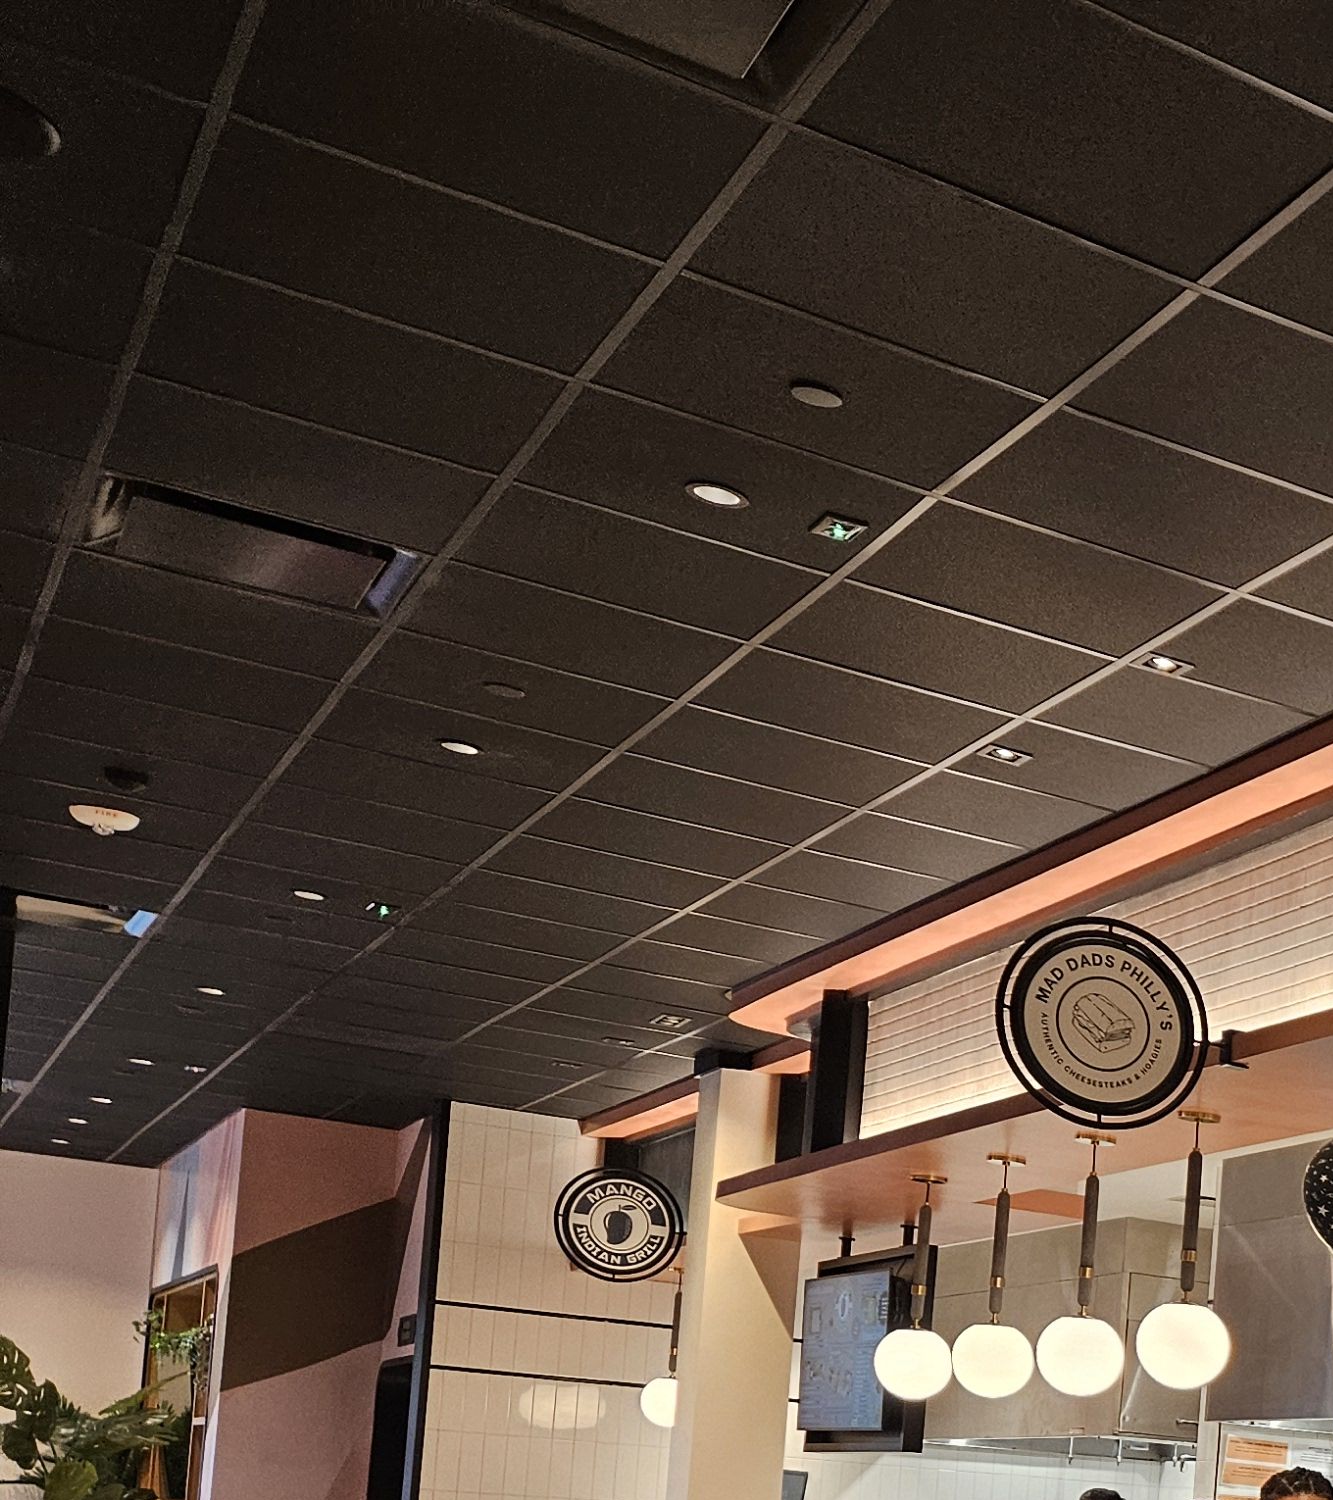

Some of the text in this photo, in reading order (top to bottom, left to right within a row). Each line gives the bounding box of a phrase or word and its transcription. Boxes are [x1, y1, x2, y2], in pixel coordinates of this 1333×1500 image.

[1035, 953, 1173, 1032] MAD DADS PHILLY'S
[1041, 1012, 1064, 1065] AUTHENTIC
[1064, 1065, 1133, 1088] CHEESESTEAKS
[586, 1184, 657, 1211] MANGO
[576, 1226, 660, 1265] INDIAN GRILL
